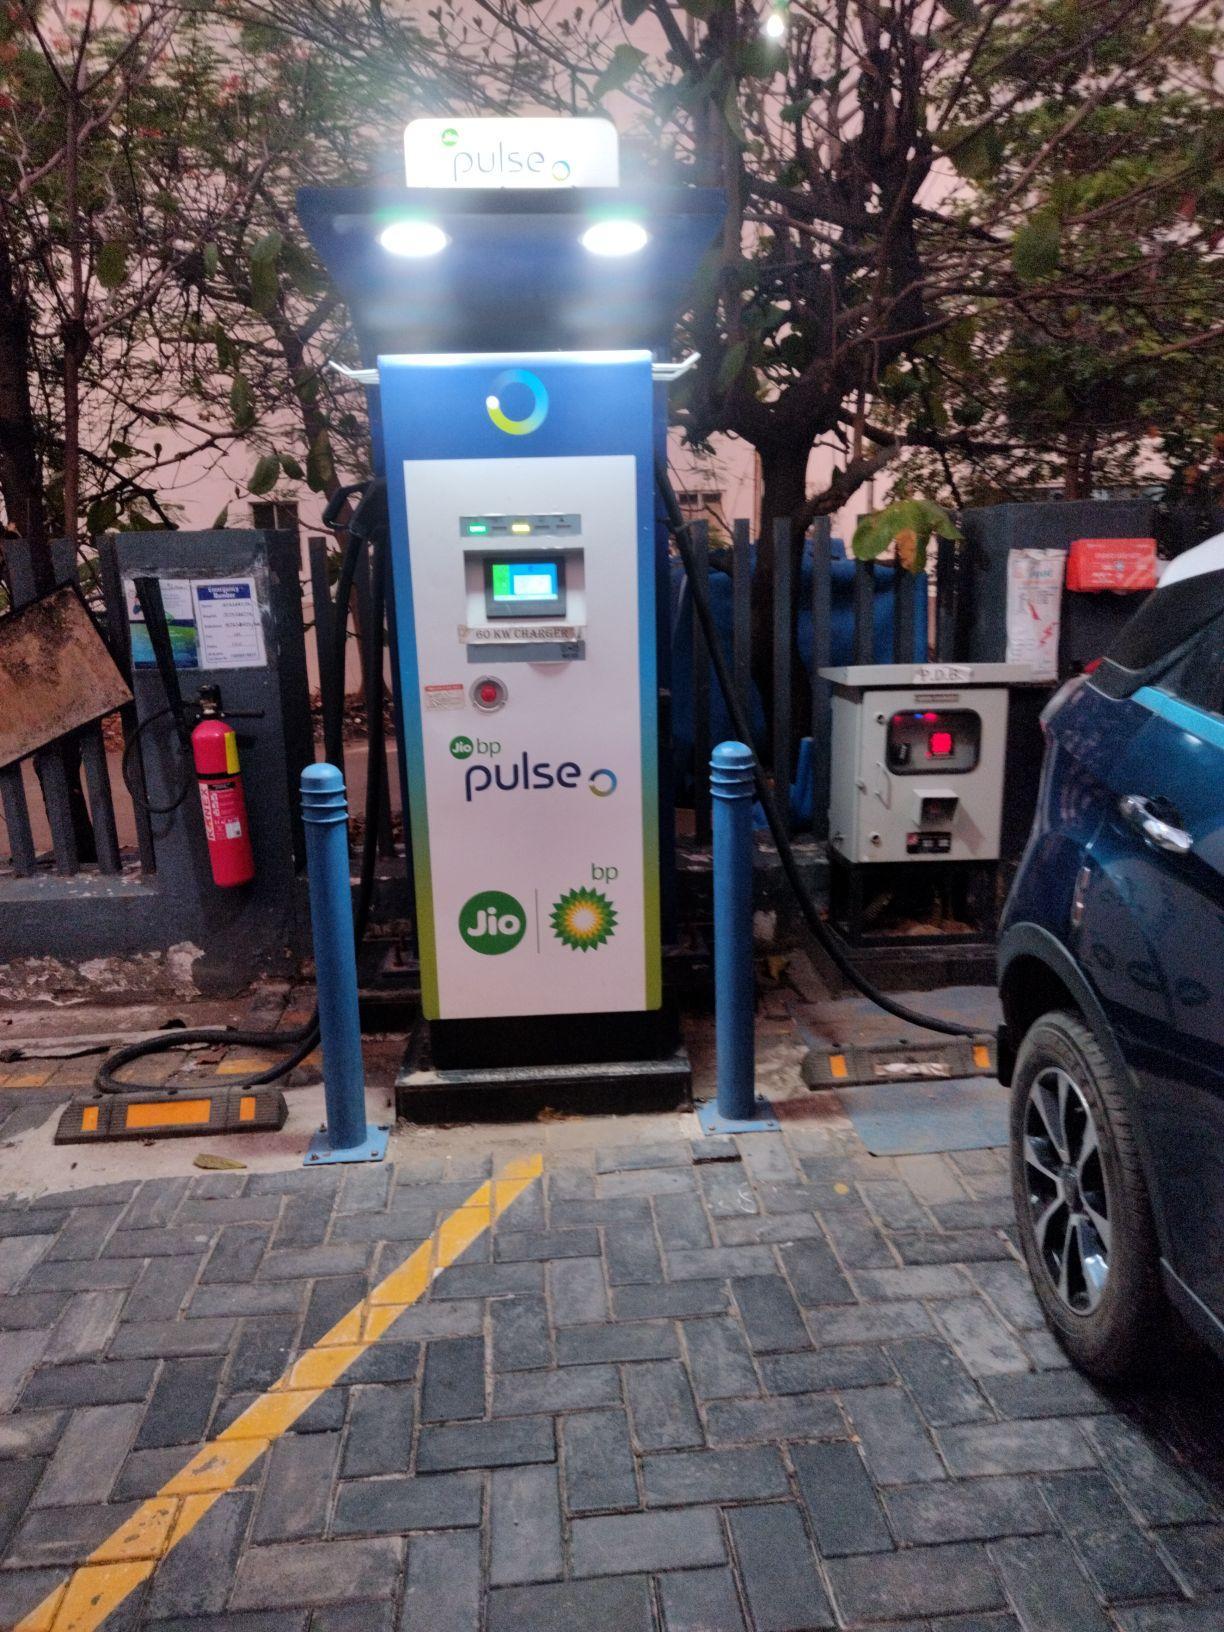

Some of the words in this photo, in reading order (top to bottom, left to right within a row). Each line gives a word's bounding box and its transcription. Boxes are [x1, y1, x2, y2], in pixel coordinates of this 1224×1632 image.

[453, 140, 545, 182] pulse
[475, 629, 491, 640] 60
[514, 627, 570, 640] CHARGER
[451, 740, 472, 753] Jio
[477, 738, 501, 758] bp
[465, 751, 581, 802] pulse
[591, 862, 619, 884] bp
[467, 906, 521, 937] Jio
